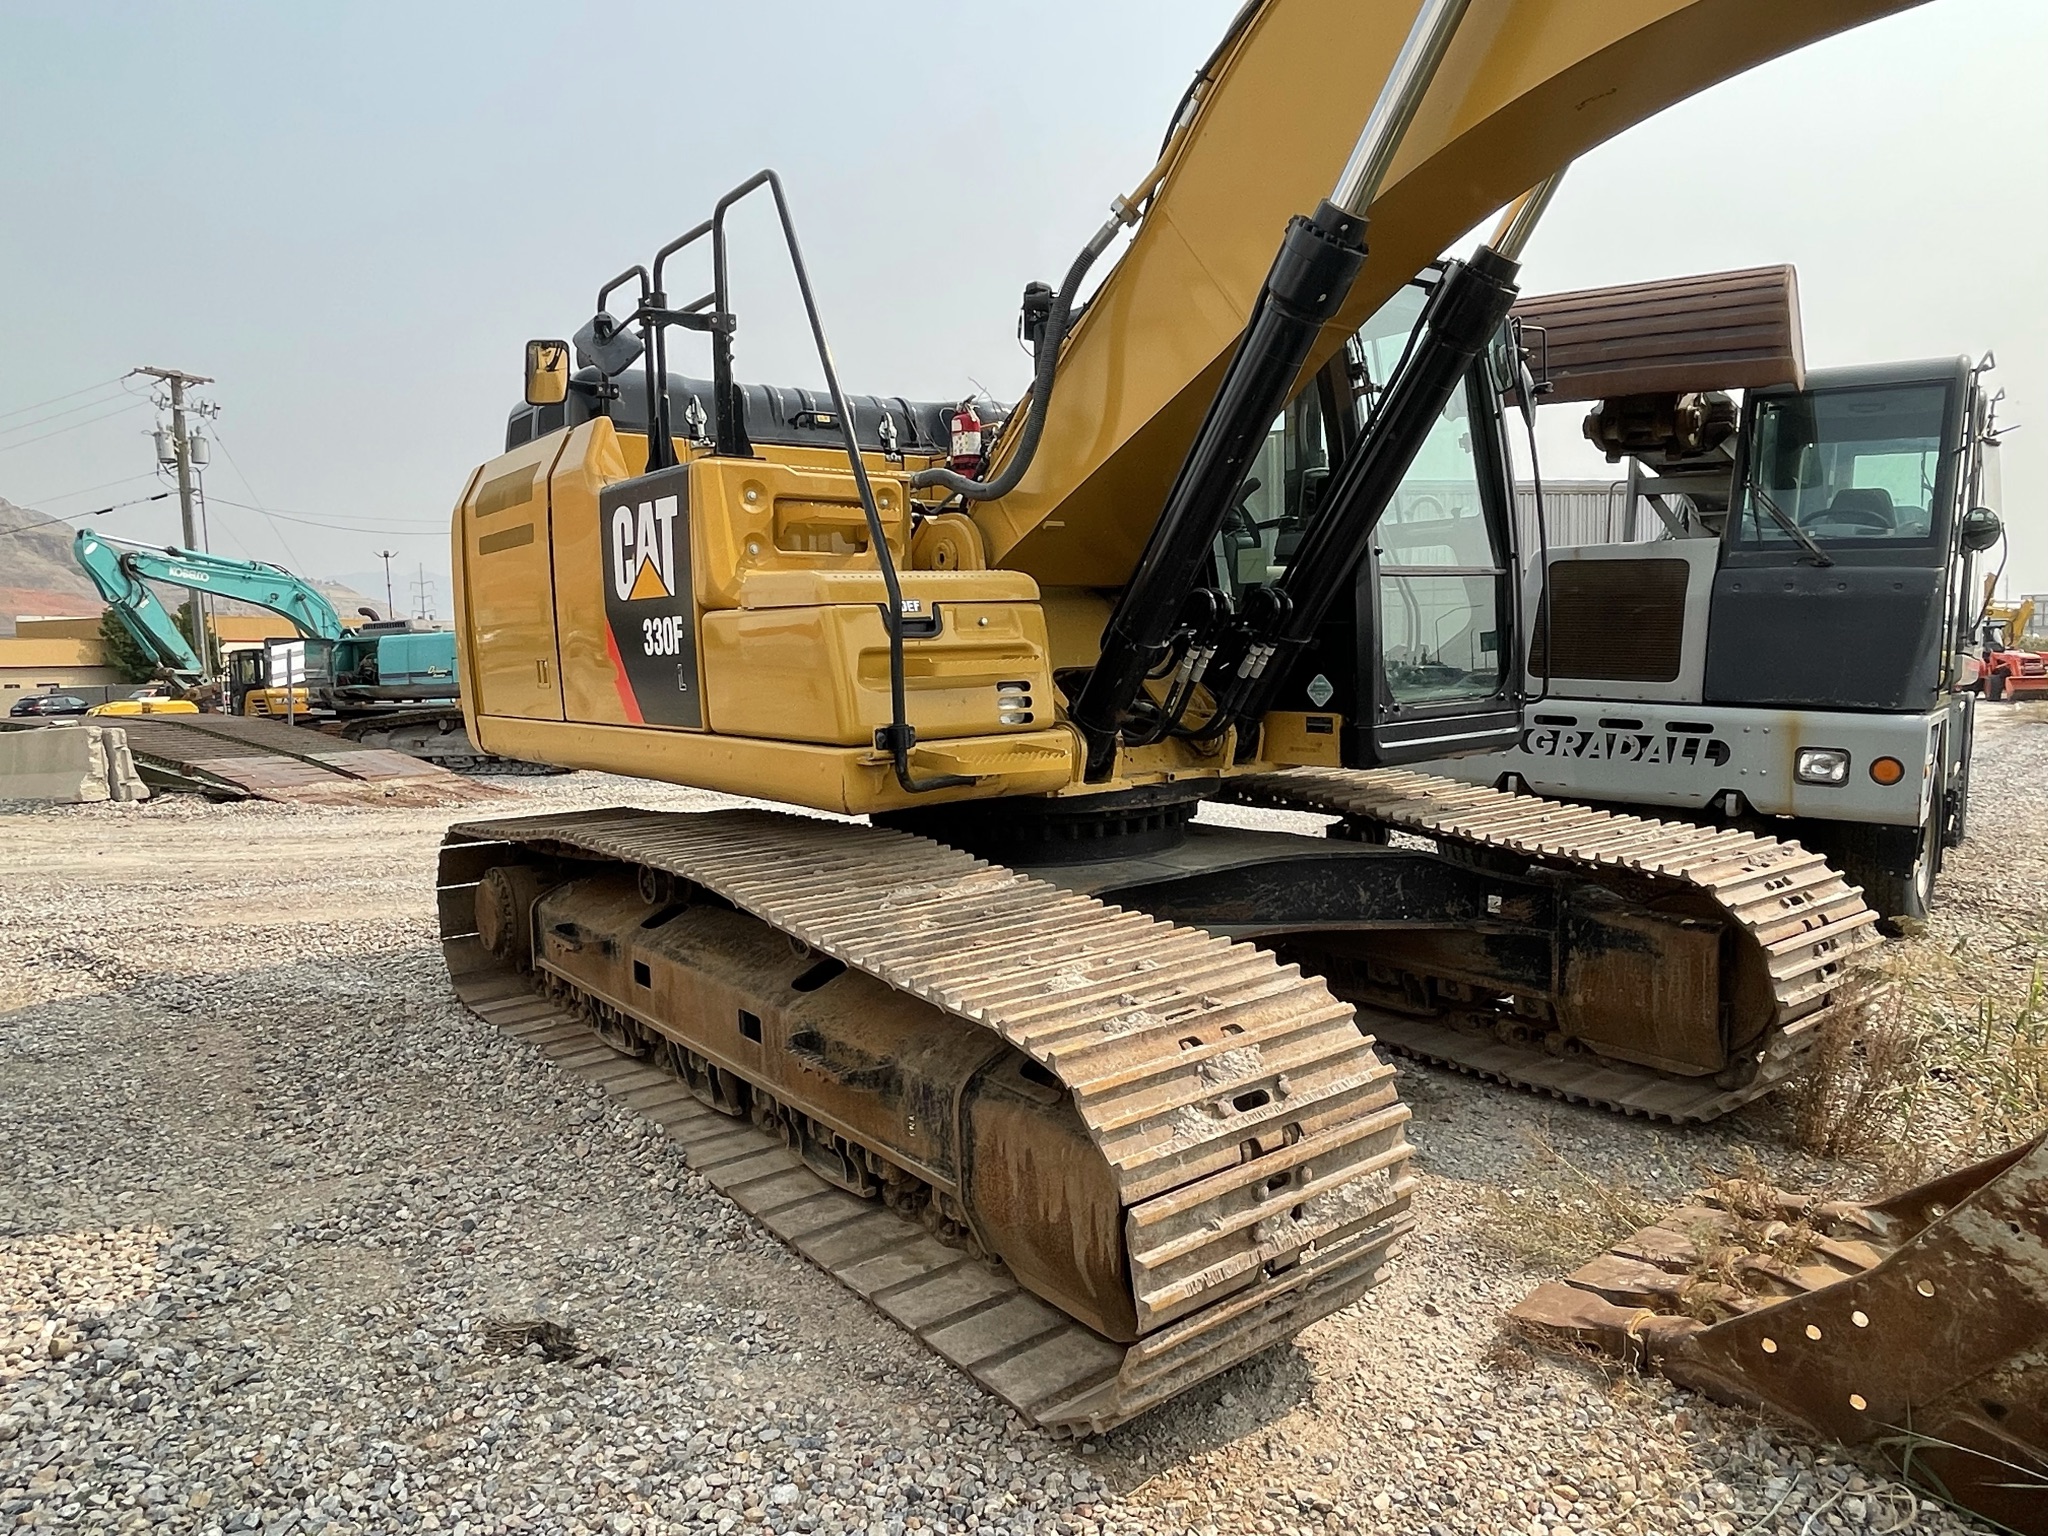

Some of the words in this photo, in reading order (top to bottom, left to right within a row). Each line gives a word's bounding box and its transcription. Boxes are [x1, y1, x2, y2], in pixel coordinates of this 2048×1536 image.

[612, 495, 677, 601] CAT
[168, 566, 210, 582] KOBELCO
[642, 615, 684, 656] 330F
[1525, 729, 1724, 767] GRADALL
